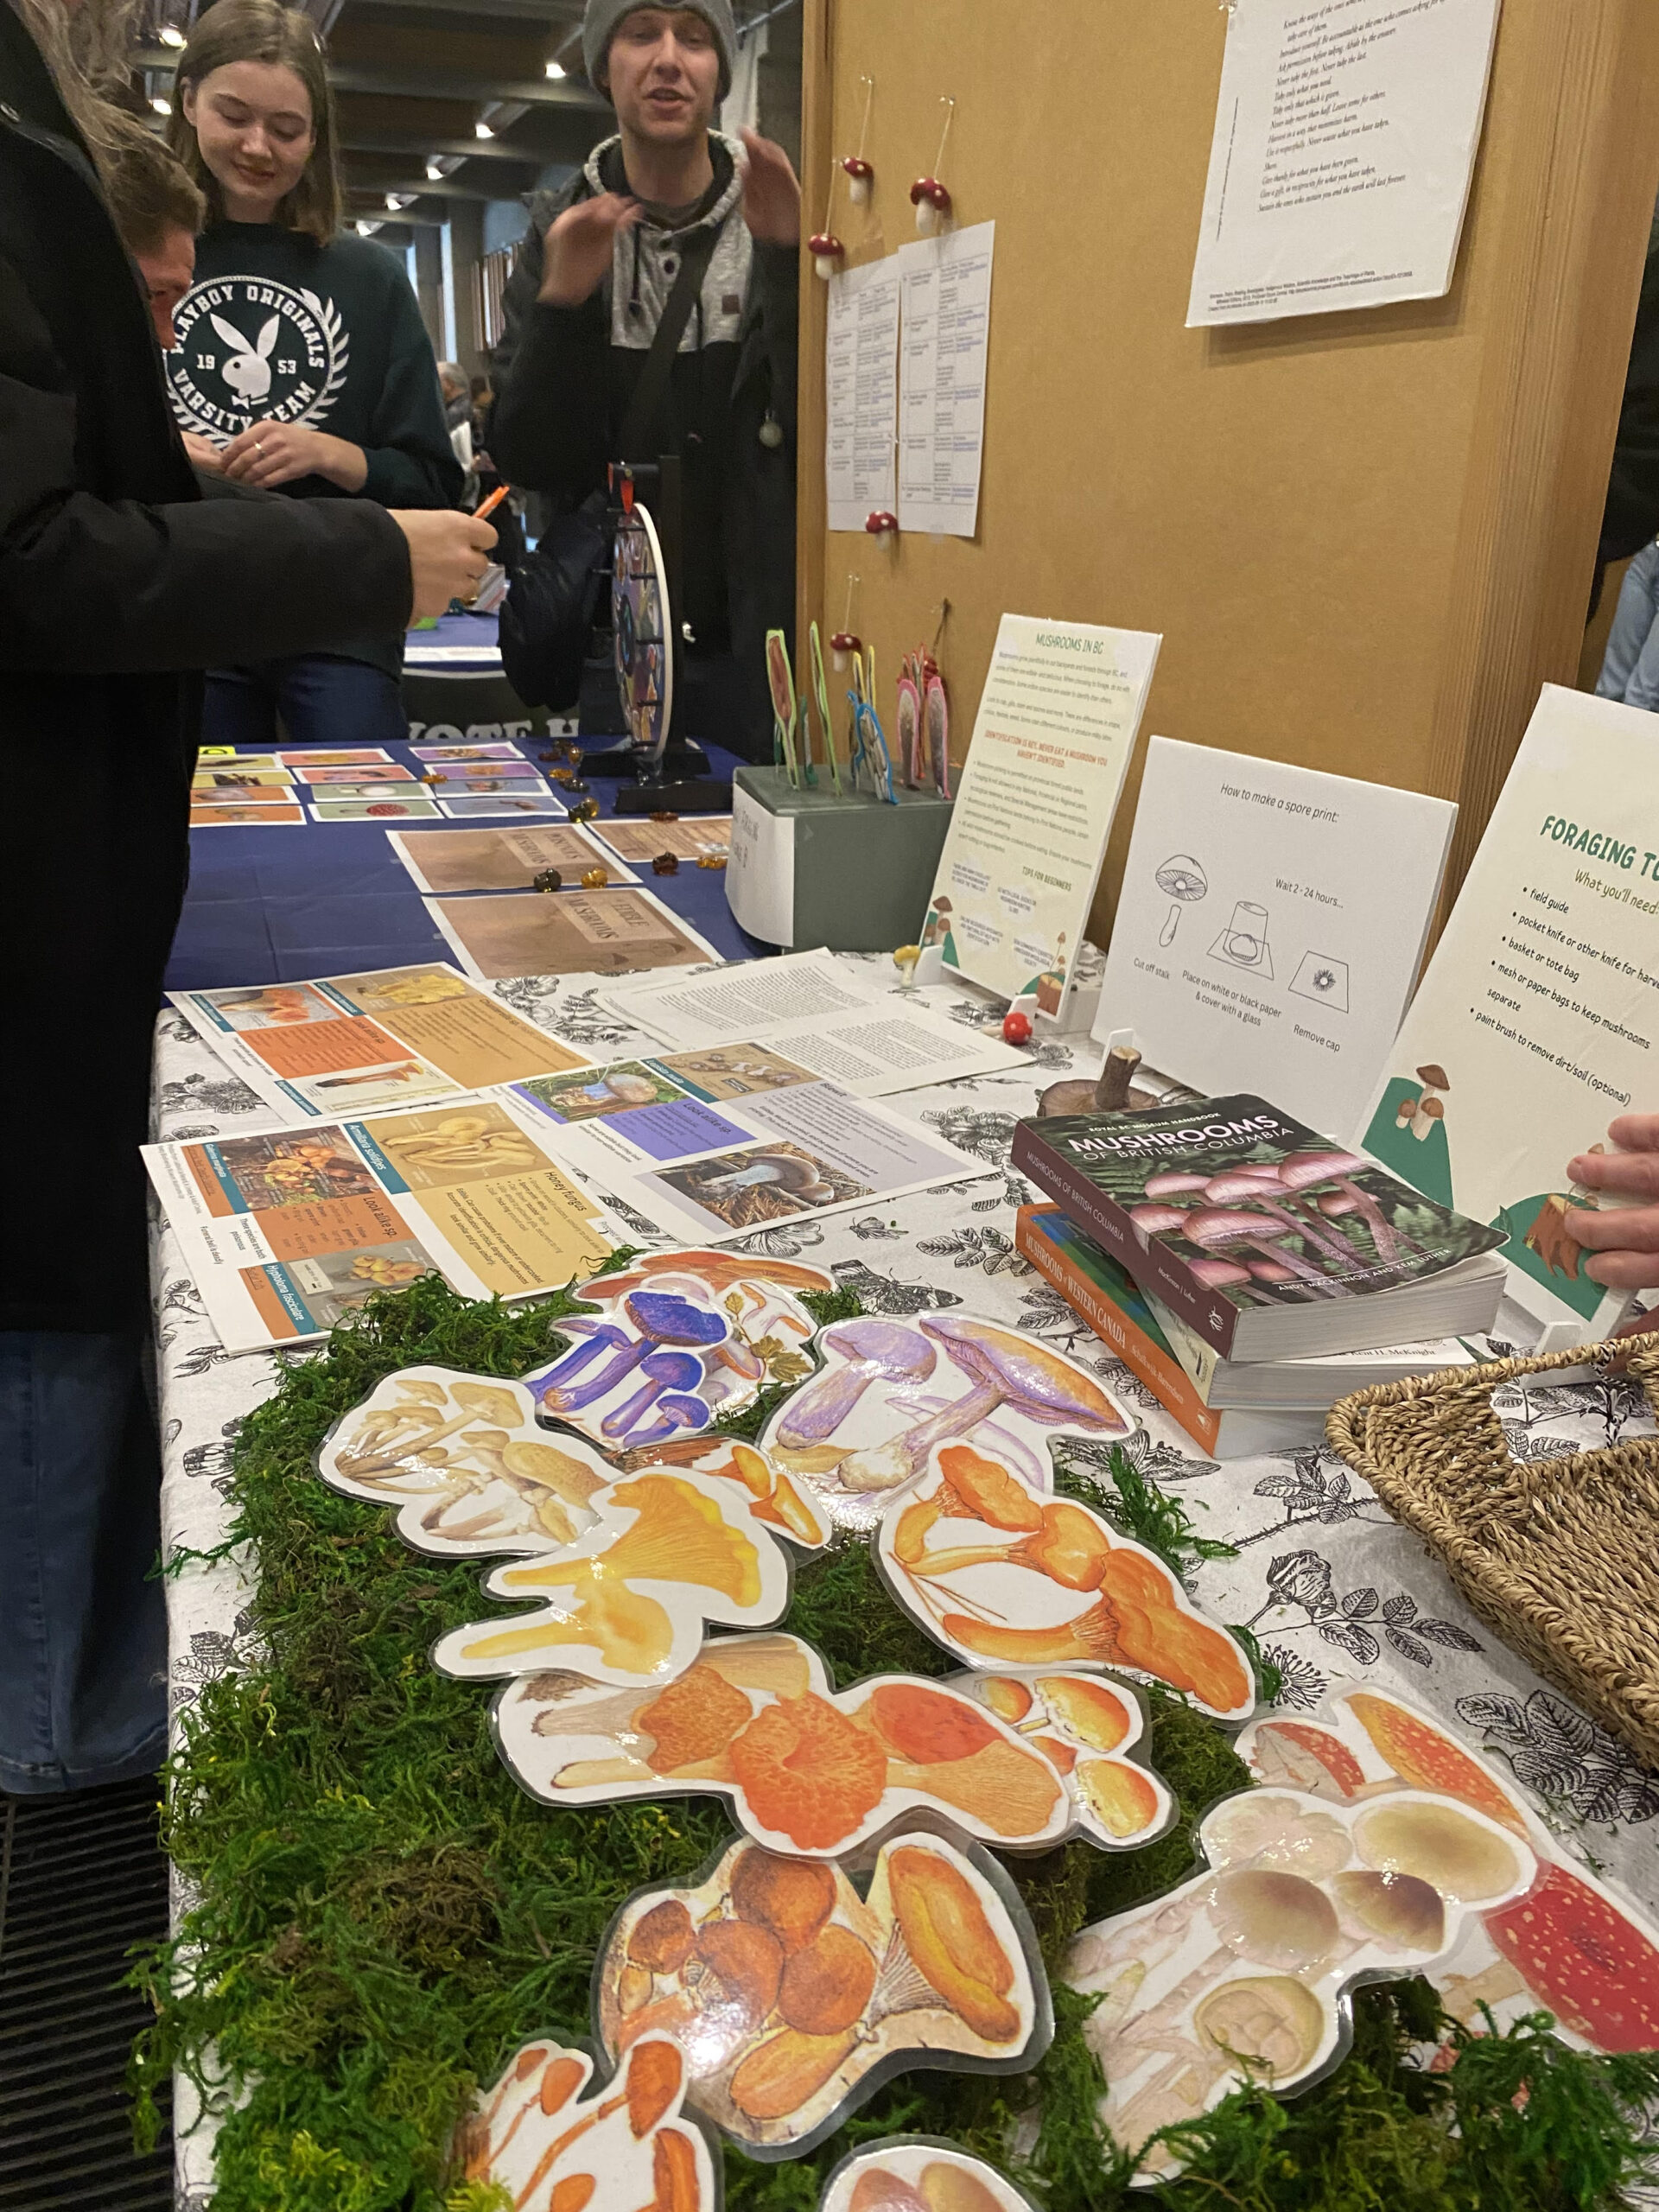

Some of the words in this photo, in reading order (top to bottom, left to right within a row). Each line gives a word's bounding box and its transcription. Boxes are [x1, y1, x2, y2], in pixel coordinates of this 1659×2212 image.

[247, 285, 324, 368] ORIGINALS
[197, 354, 215, 370] 19
[277, 359, 296, 374] 53
[174, 368, 253, 432] VARSITY
[262, 381, 316, 422] TEAM
[1035, 632, 1082, 652] MUSHROOMS
[1081, 639, 1092, 652] IN
[1091, 640, 1104, 655] BC
[1038, 742, 1054, 753] NEVER
[1220, 783, 1241, 798] How
[1241, 788, 1250, 800] to
[1250, 792, 1276, 806] make
[1276, 798, 1284, 809] a
[1284, 801, 1312, 816] spore
[1311, 808, 1339, 823] print:
[1540, 815, 1637, 869] FORAGING
[1033, 870, 1044, 881] FOR
[1043, 874, 1071, 892] BEGINNERS
[1275, 877, 1293, 892] Wait
[1293, 883, 1299, 893] 2
[1303, 887, 1313, 899] 24
[1574, 868, 1602, 892] What
[1599, 884, 1631, 903] you'll
[1529, 887, 1549, 904] field
[1546, 899, 1569, 913] guide
[1508, 936, 1535, 958] basket
[1535, 953, 1545, 963] or
[1545, 957, 1563, 972] tote
[1563, 963, 1580, 983] bag
[1517, 915, 1546, 933] pocket
[1545, 925, 1566, 943] knife
[1566, 938, 1576, 947] or
[1576, 942, 1600, 958] other
[1599, 950, 1621, 969] knife
[1621, 962, 1637, 976] for
[1133, 957, 1145, 969] Cut
[1144, 963, 1155, 973] off
[1154, 967, 1170, 980] stalk
[1181, 969, 1201, 985] Place
[1200, 979, 1210, 988] on
[1211, 983, 1230, 997] white
[1230, 991, 1239, 1000] or
[1239, 992, 1259, 1009] black
[1258, 1002, 1281, 1018] paper
[1195, 990, 1200, 1001] &
[1201, 995, 1220, 1008] cover
[1221, 1002, 1236, 1015] with
[1236, 1009, 1242, 1019] a
[1242, 1012, 1262, 1027] glass
[1486, 988, 1521, 1012] separate
[1497, 963, 1516, 979] mesh
[1516, 974, 1527, 983] or
[1525, 979, 1551, 995] paper
[1550, 988, 1570, 1007] bags
[1570, 1001, 1580, 1013] to
[1580, 1004, 1601, 1025] keep
[1600, 1019, 1650, 1049] mushrooms
[1293, 1023, 1325, 1046] Remove
[1325, 1039, 1340, 1053] cap
[1474, 1012, 1496, 1028] paint
[1495, 1019, 1516, 1040] brush
[1517, 1033, 1527, 1046] to
[1526, 1040, 1554, 1062] remove
[1554, 1055, 1589, 1081] dirt/soil
[1586, 1073, 1630, 1107] (optional)
[1068, 1115, 1279, 1152] MUSHROOMS
[1133, 1121, 1169, 1129] MUSEUM
[1172, 1112, 1221, 1125] HANDBOOK
[1083, 1151, 1112, 1160] OF
[1118, 1145, 1187, 1159] BRITISH
[1193, 1127, 1295, 1152] COLUMBIA
[362, 1196, 383, 1212] Look
[543, 1171, 568, 1191] Honey
[561, 1190, 587, 1211] fungus
[1026, 1151, 1063, 1187] MUSHROOMS
[1062, 1181, 1071, 1194] OF
[1071, 1190, 1092, 1215] BRITISH
[1092, 1209, 1124, 1241] COLUMBIA
[372, 1211, 391, 1228] alike
[1307, 1273, 1370, 1287] MACKINNON
[1372, 1266, 1394, 1279] AND
[1395, 1261, 1415, 1271] KEM
[1417, 1249, 1452, 1263] LUTHER
[1025, 1232, 1064, 1282] MUSHROOMS
[1067, 1274, 1098, 1318] WESTERN
[1097, 1308, 1126, 1349] CANADA
